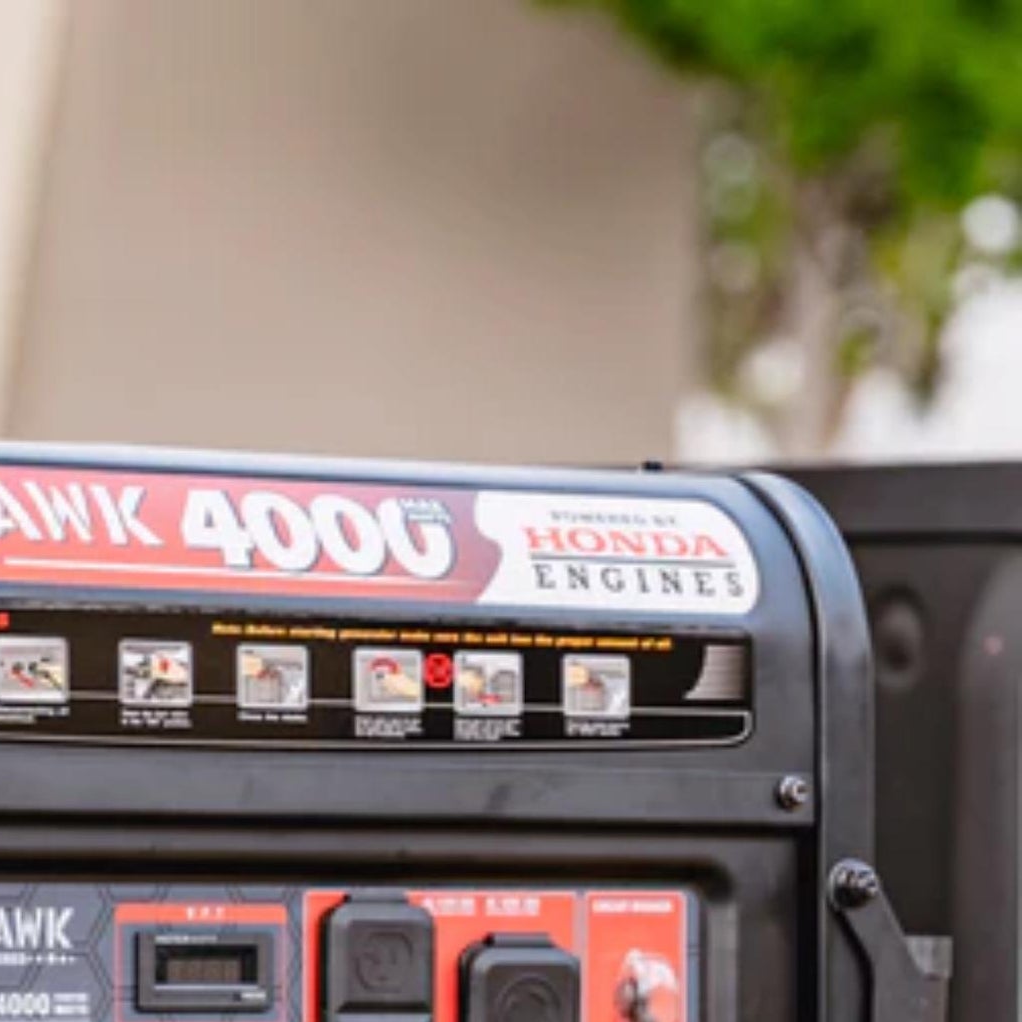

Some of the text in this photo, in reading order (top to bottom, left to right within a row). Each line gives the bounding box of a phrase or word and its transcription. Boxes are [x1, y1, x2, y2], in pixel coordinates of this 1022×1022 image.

[182, 489, 458, 580] 4000
[523, 526, 729, 558] HONDA
[532, 563, 745, 598] ENGINES
